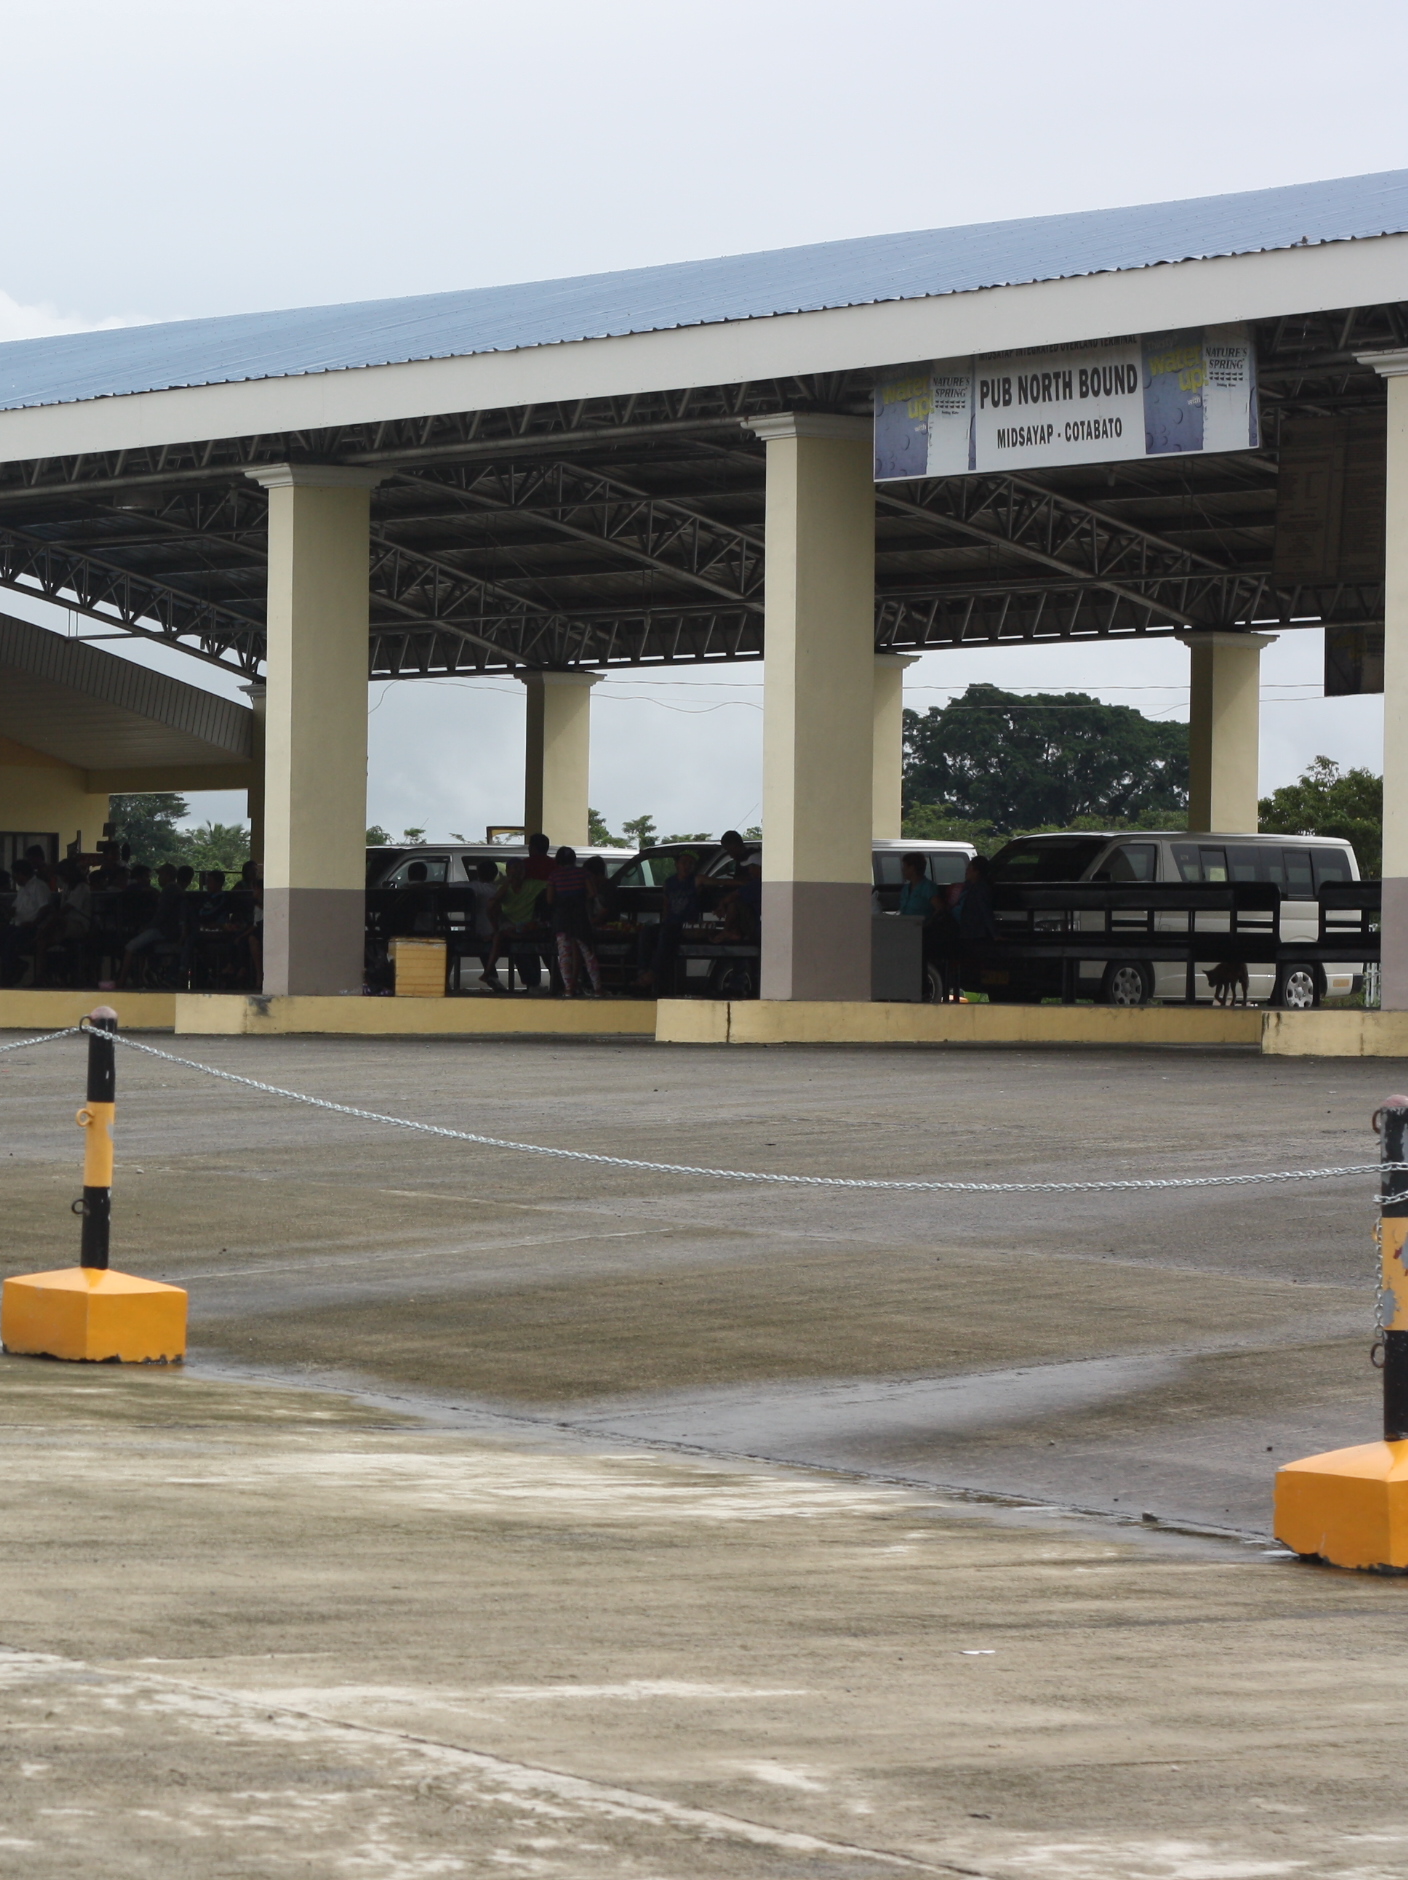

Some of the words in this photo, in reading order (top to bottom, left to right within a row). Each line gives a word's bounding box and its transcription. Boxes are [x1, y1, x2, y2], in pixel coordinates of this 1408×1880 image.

[1100, 334, 1137, 347] TERMINAL
[1205, 347, 1248, 357] NATURE'S
[1148, 345, 1202, 376] water
[1209, 359, 1243, 369] SPRING
[935, 388, 966, 398] SPRING
[980, 377, 1012, 409] PUB
[1018, 370, 1073, 405] NORTH
[1079, 364, 1138, 399] BOUND
[997, 424, 1053, 449] MIDSAYAP
[1065, 417, 1122, 442] COTABATO
